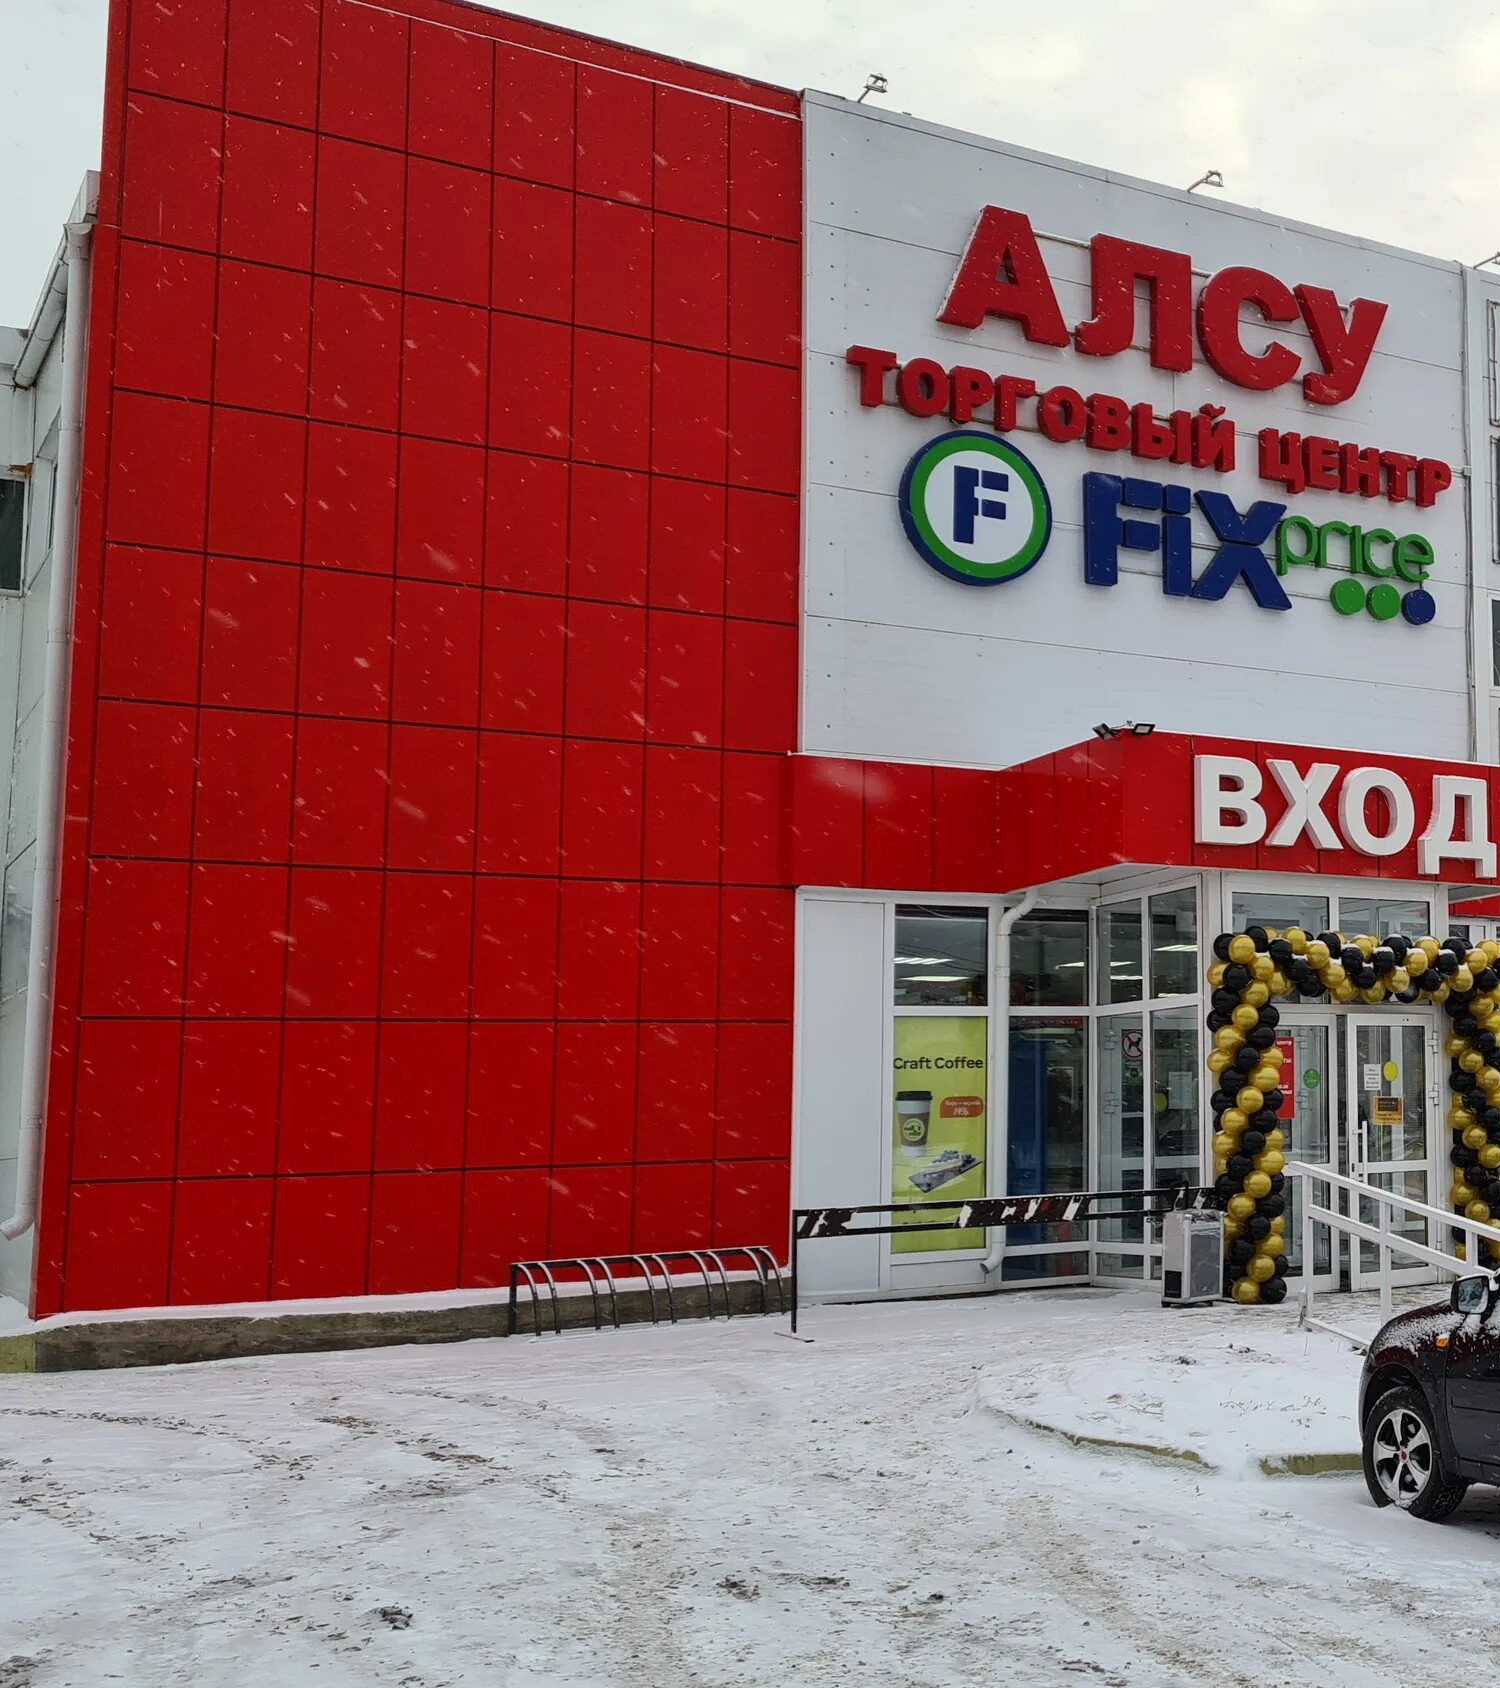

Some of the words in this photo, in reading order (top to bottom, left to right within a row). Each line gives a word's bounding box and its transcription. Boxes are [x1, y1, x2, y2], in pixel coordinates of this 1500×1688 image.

[936, 205, 1388, 405] АЛСУ
[846, 345, 1235, 471] ТОРГОВЫЙ
[1258, 427, 1452, 507] ЦЕНТР
[953, 465, 1009, 545] F
[1276, 515, 1435, 582] price
[1194, 754, 1498, 879] ВХОД
[893, 1057, 932, 1069] Craft
[934, 1057, 983, 1069] Coffee
